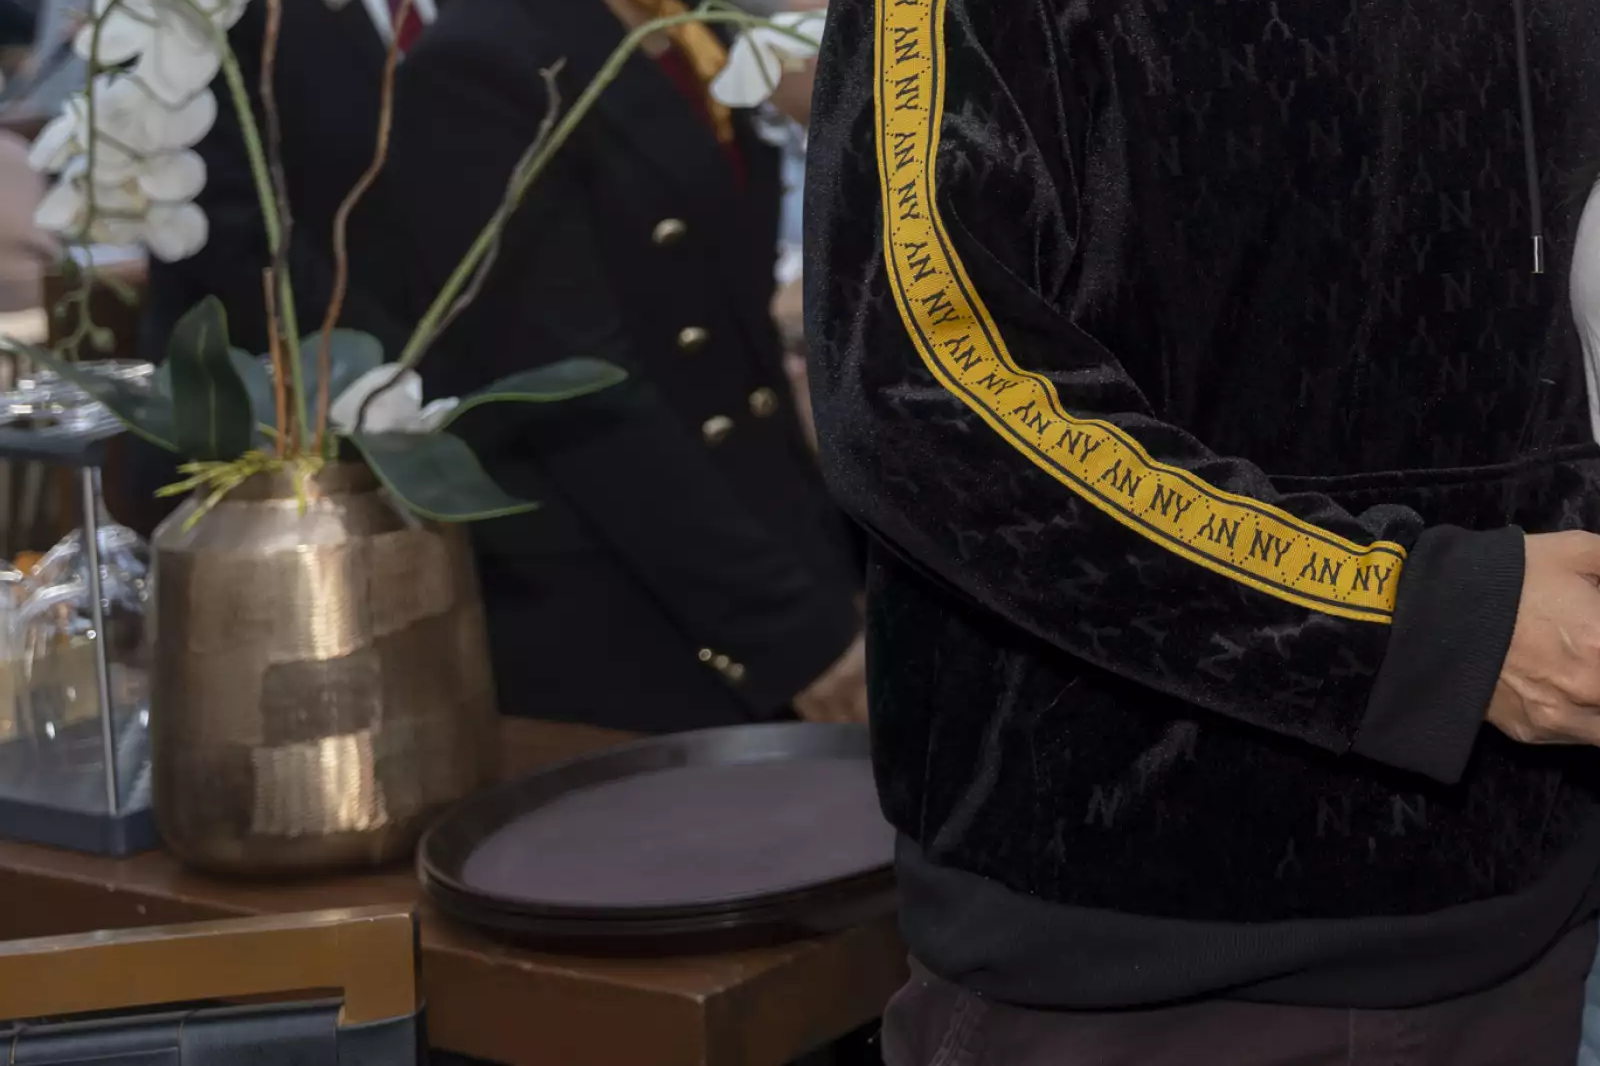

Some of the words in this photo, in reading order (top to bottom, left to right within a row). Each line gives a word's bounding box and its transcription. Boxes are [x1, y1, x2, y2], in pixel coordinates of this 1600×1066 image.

[894, 26, 920, 64] NY
[895, 73, 920, 111] NY
[894, 132, 917, 171] NY
[898, 179, 921, 221] NY
[904, 241, 937, 283] NY
[922, 289, 961, 326] NY
[944, 334, 983, 372] NY
[976, 372, 1019, 396] NY
[1012, 399, 1052, 435] NY
[1056, 428, 1101, 463] NY
[1101, 458, 1142, 497] NY
[1149, 484, 1192, 523] NY
[1197, 513, 1240, 549] NY
[1249, 528, 1292, 567] NY
[1299, 551, 1343, 586] NY
[1351, 564, 1392, 595] NY
